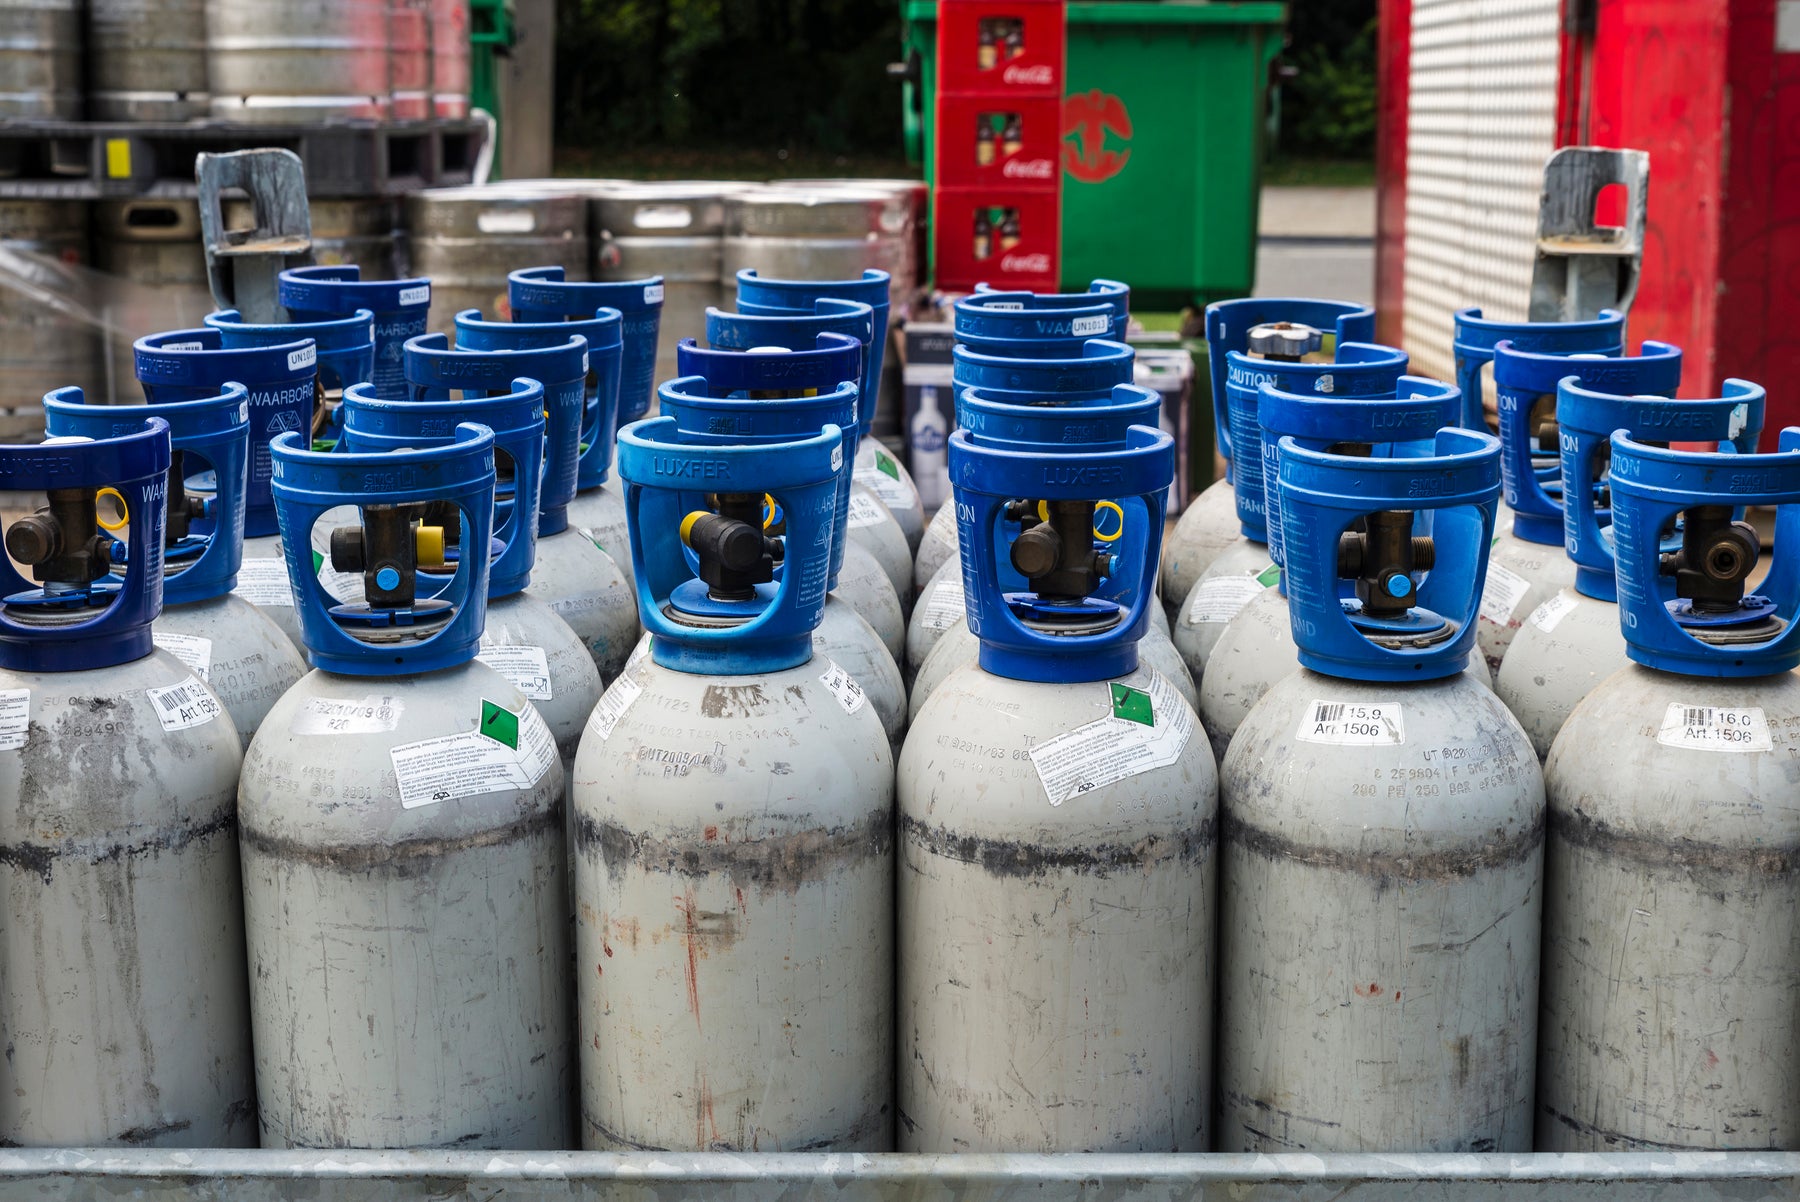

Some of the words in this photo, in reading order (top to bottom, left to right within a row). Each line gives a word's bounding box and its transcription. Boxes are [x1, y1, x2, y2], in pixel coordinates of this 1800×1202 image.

[375, 318, 426, 338] AARBORG
[1074, 319, 1106, 333] UN1013
[249, 381, 314, 408] WAARBORG
[653, 455, 732, 480] LUXFER
[1349, 707, 1382, 720] 15,9
